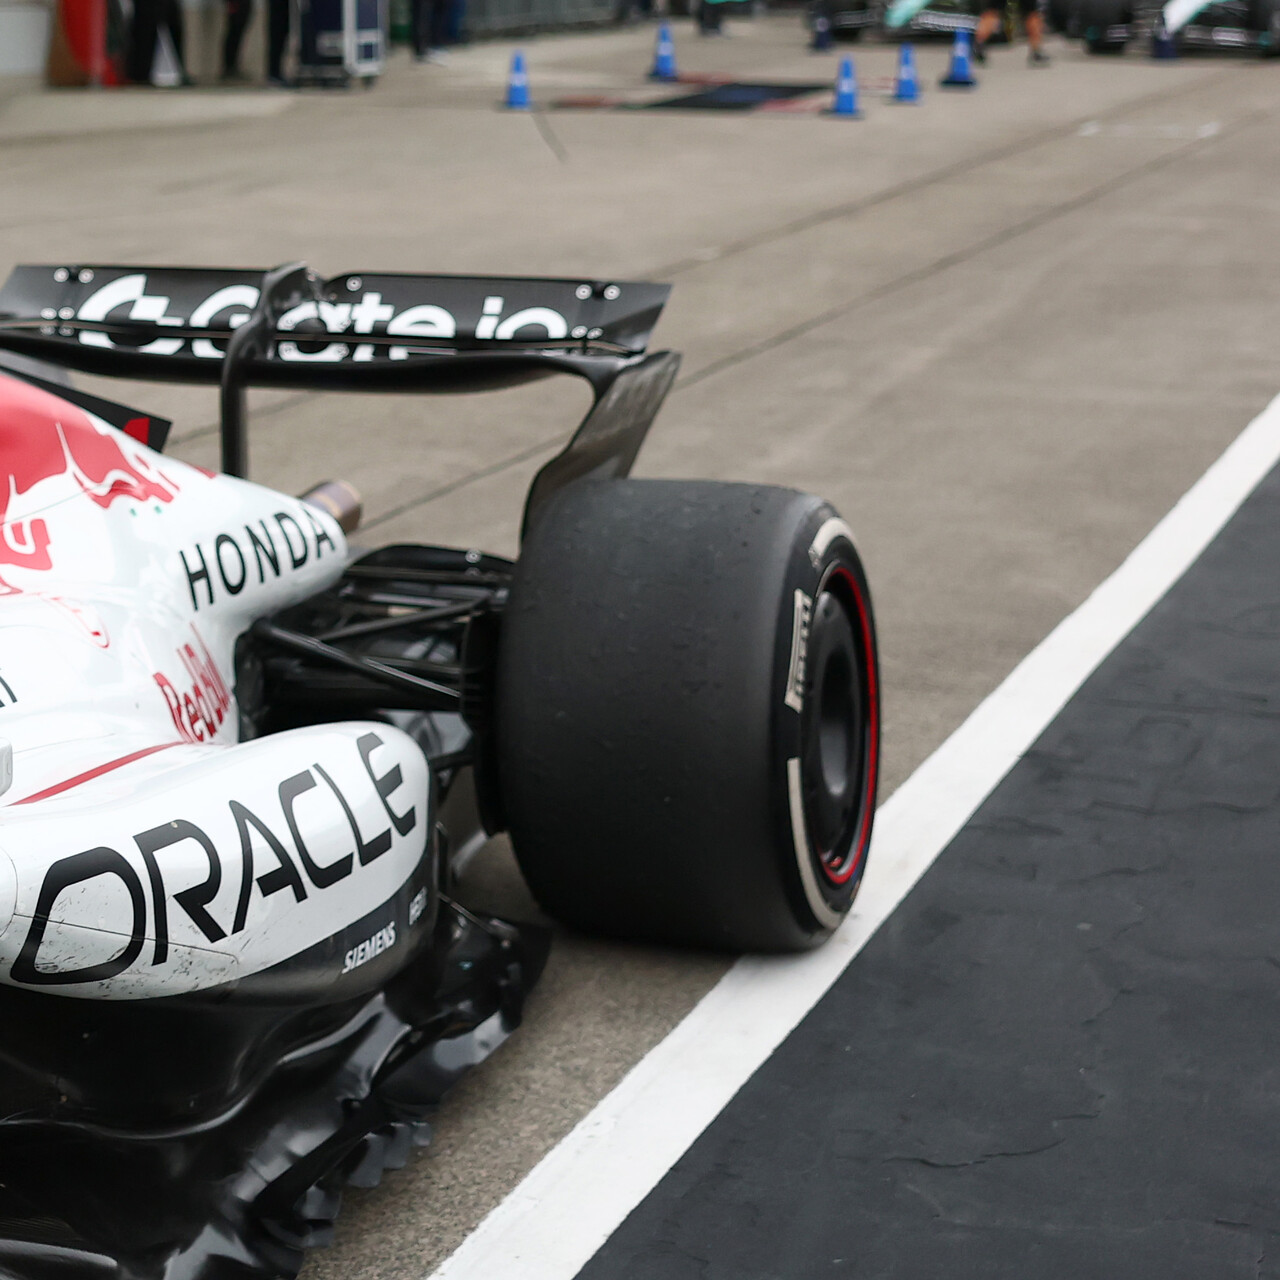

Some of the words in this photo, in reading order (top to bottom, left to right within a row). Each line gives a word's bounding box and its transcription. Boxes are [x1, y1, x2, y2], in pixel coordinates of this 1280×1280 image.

[179, 501, 336, 611] HONDA
[10, 732, 416, 985] ORACLE
[342, 920, 396, 974] SIEMENS
